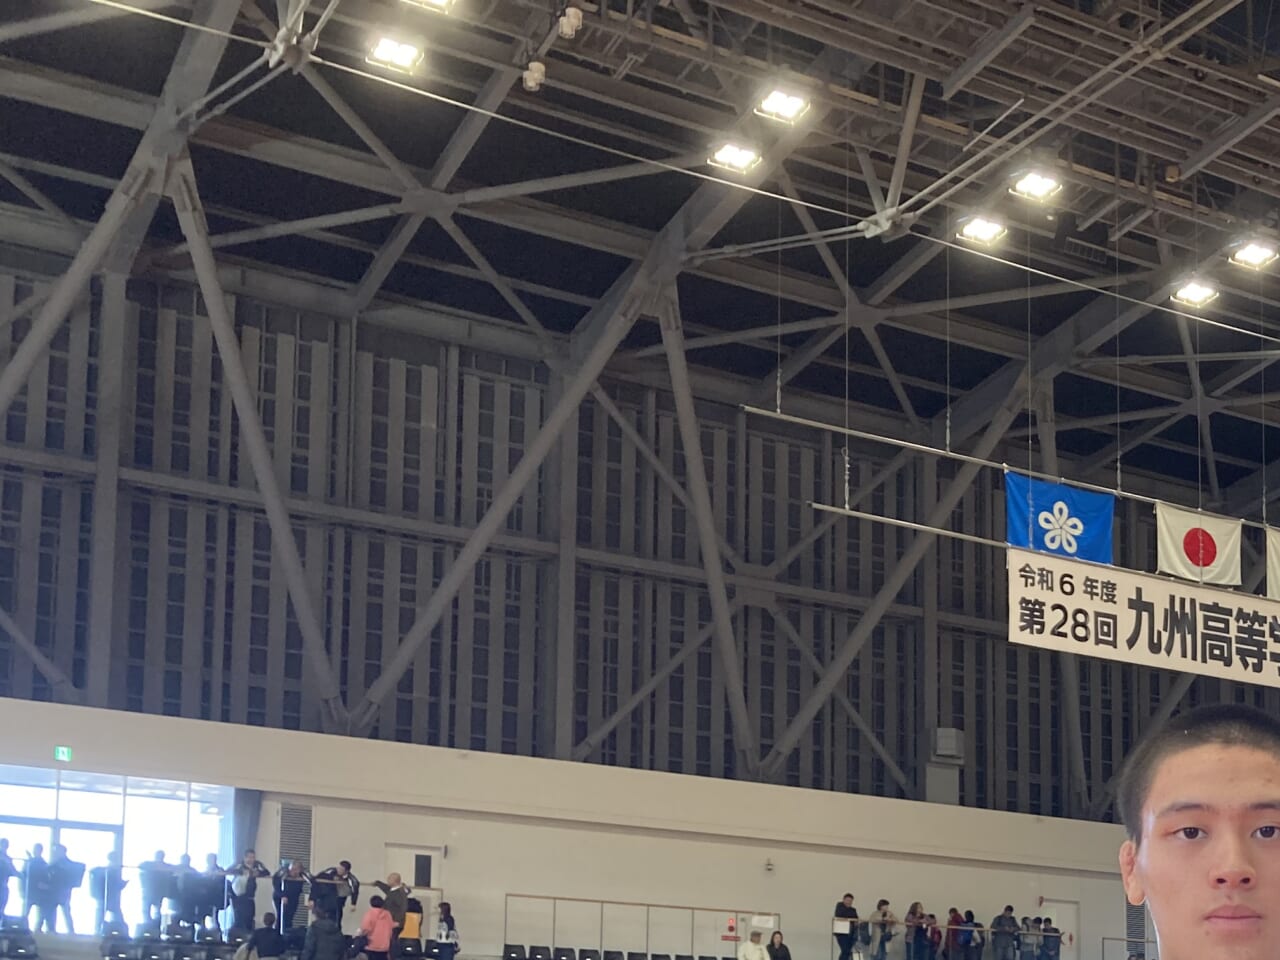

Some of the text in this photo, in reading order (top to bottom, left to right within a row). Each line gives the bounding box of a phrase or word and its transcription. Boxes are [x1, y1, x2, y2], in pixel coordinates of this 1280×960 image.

[1018, 563, 1118, 605] 令和6年度
[1018, 597, 1118, 649] 第28回
